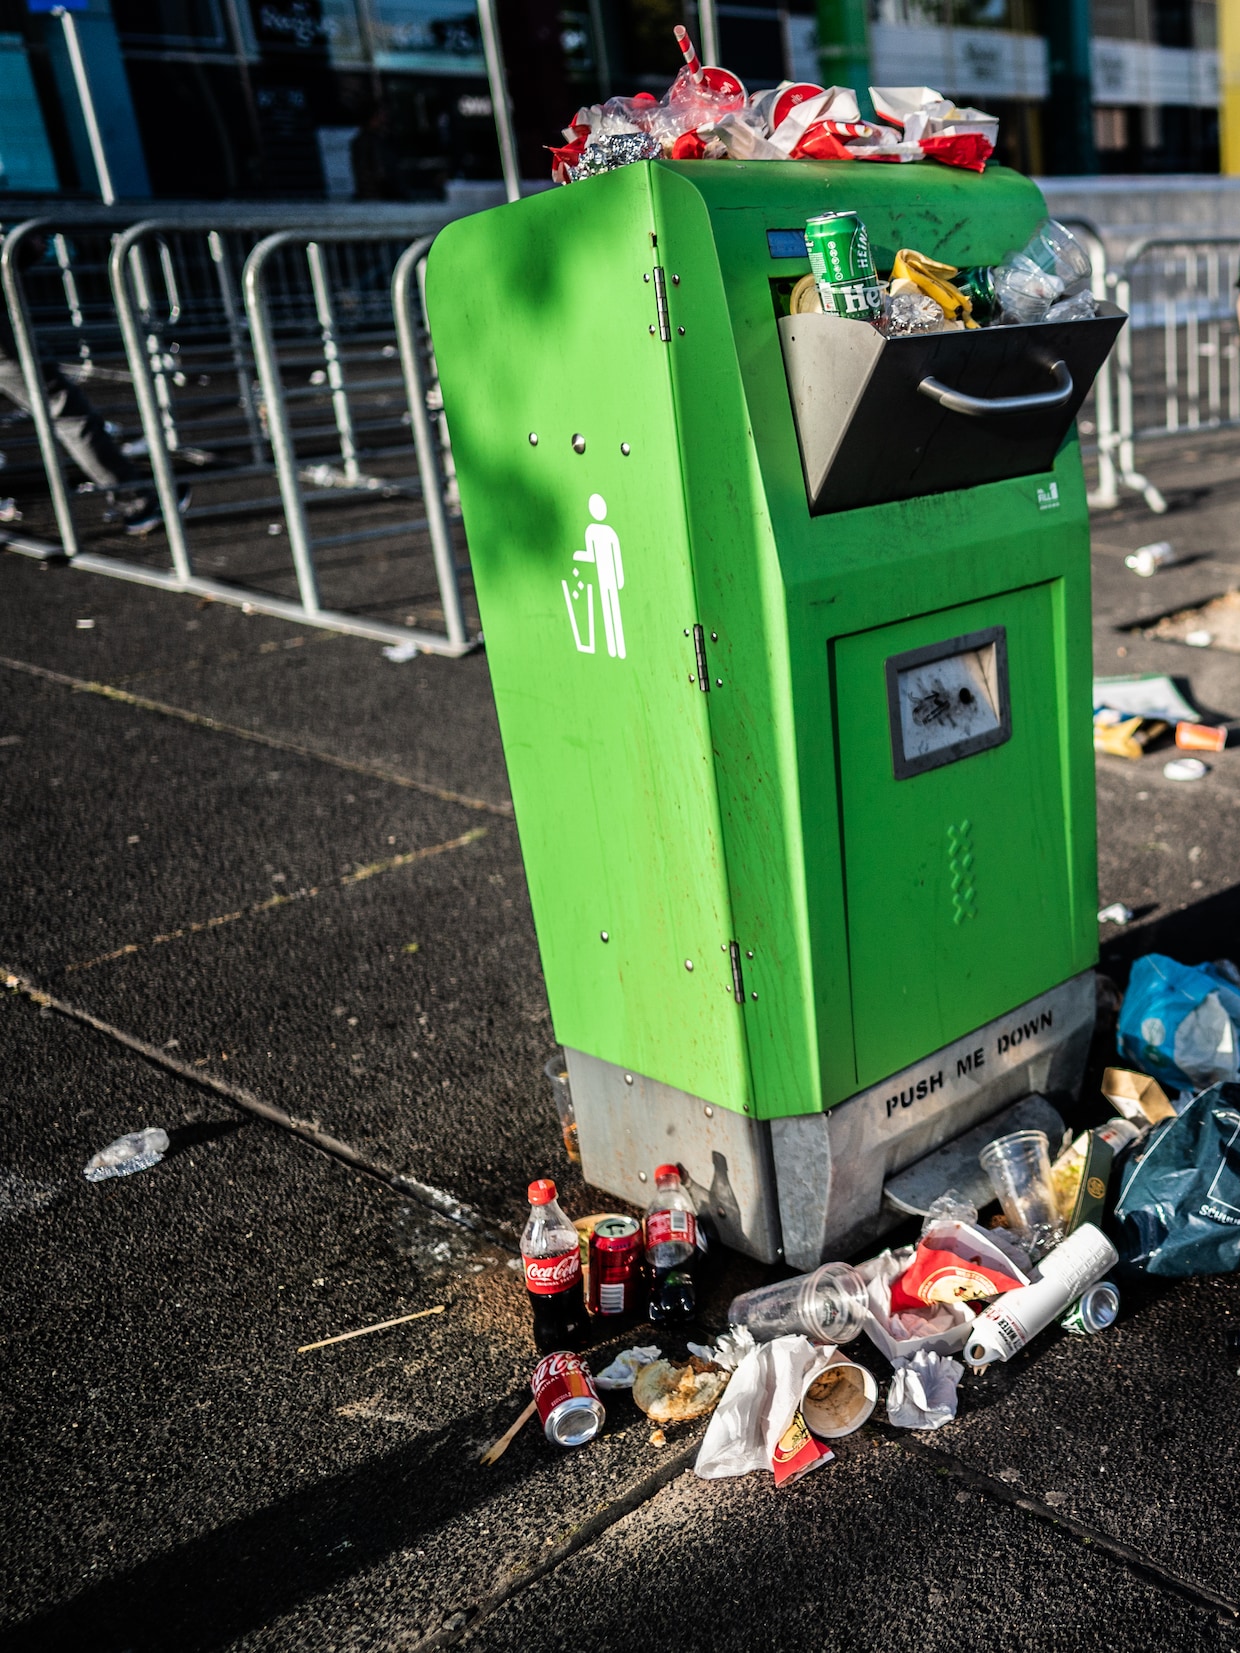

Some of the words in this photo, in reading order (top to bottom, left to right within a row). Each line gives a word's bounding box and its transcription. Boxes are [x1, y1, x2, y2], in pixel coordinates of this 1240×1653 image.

[886, 1071, 943, 1117] PUSH
[956, 1048, 984, 1078] ME
[997, 1010, 1053, 1055] DOWN
